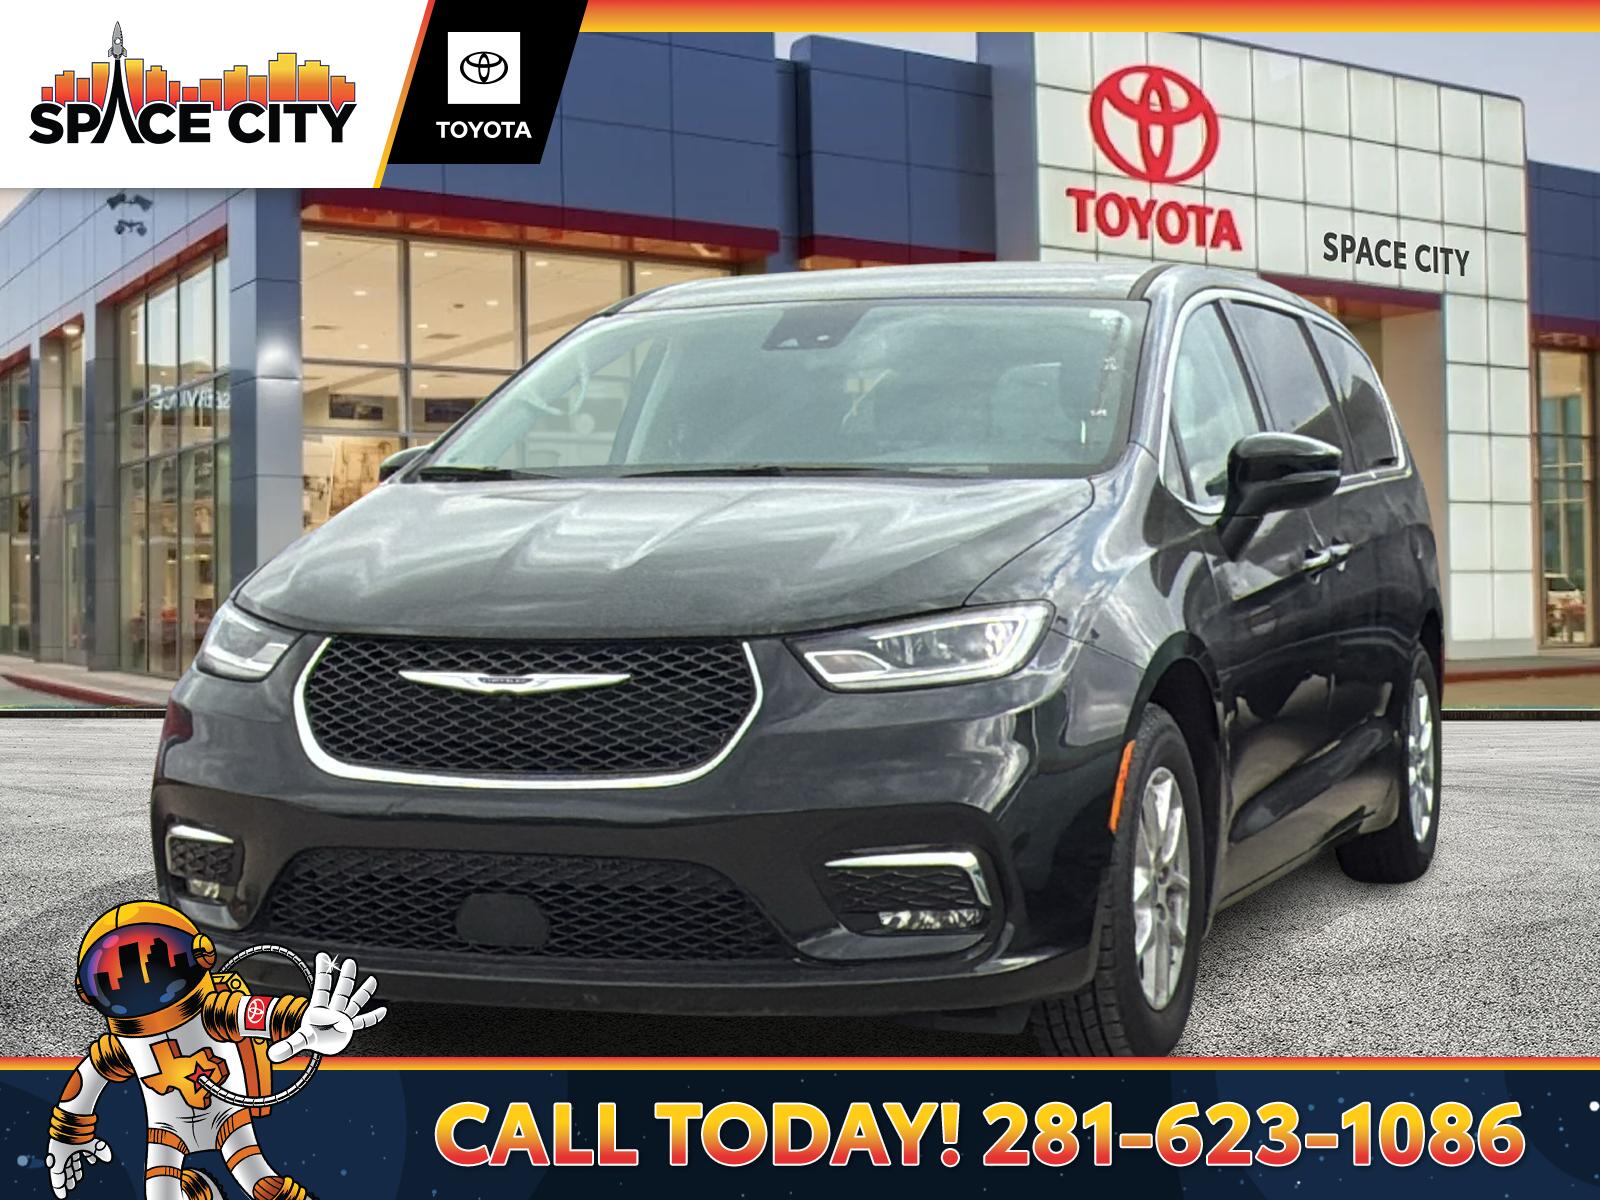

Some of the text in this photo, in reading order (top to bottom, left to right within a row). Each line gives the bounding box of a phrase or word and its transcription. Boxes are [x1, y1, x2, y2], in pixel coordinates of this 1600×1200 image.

[1066, 187, 1243, 252] TOYOTA
[1323, 231, 1471, 277] SPACE CITY
